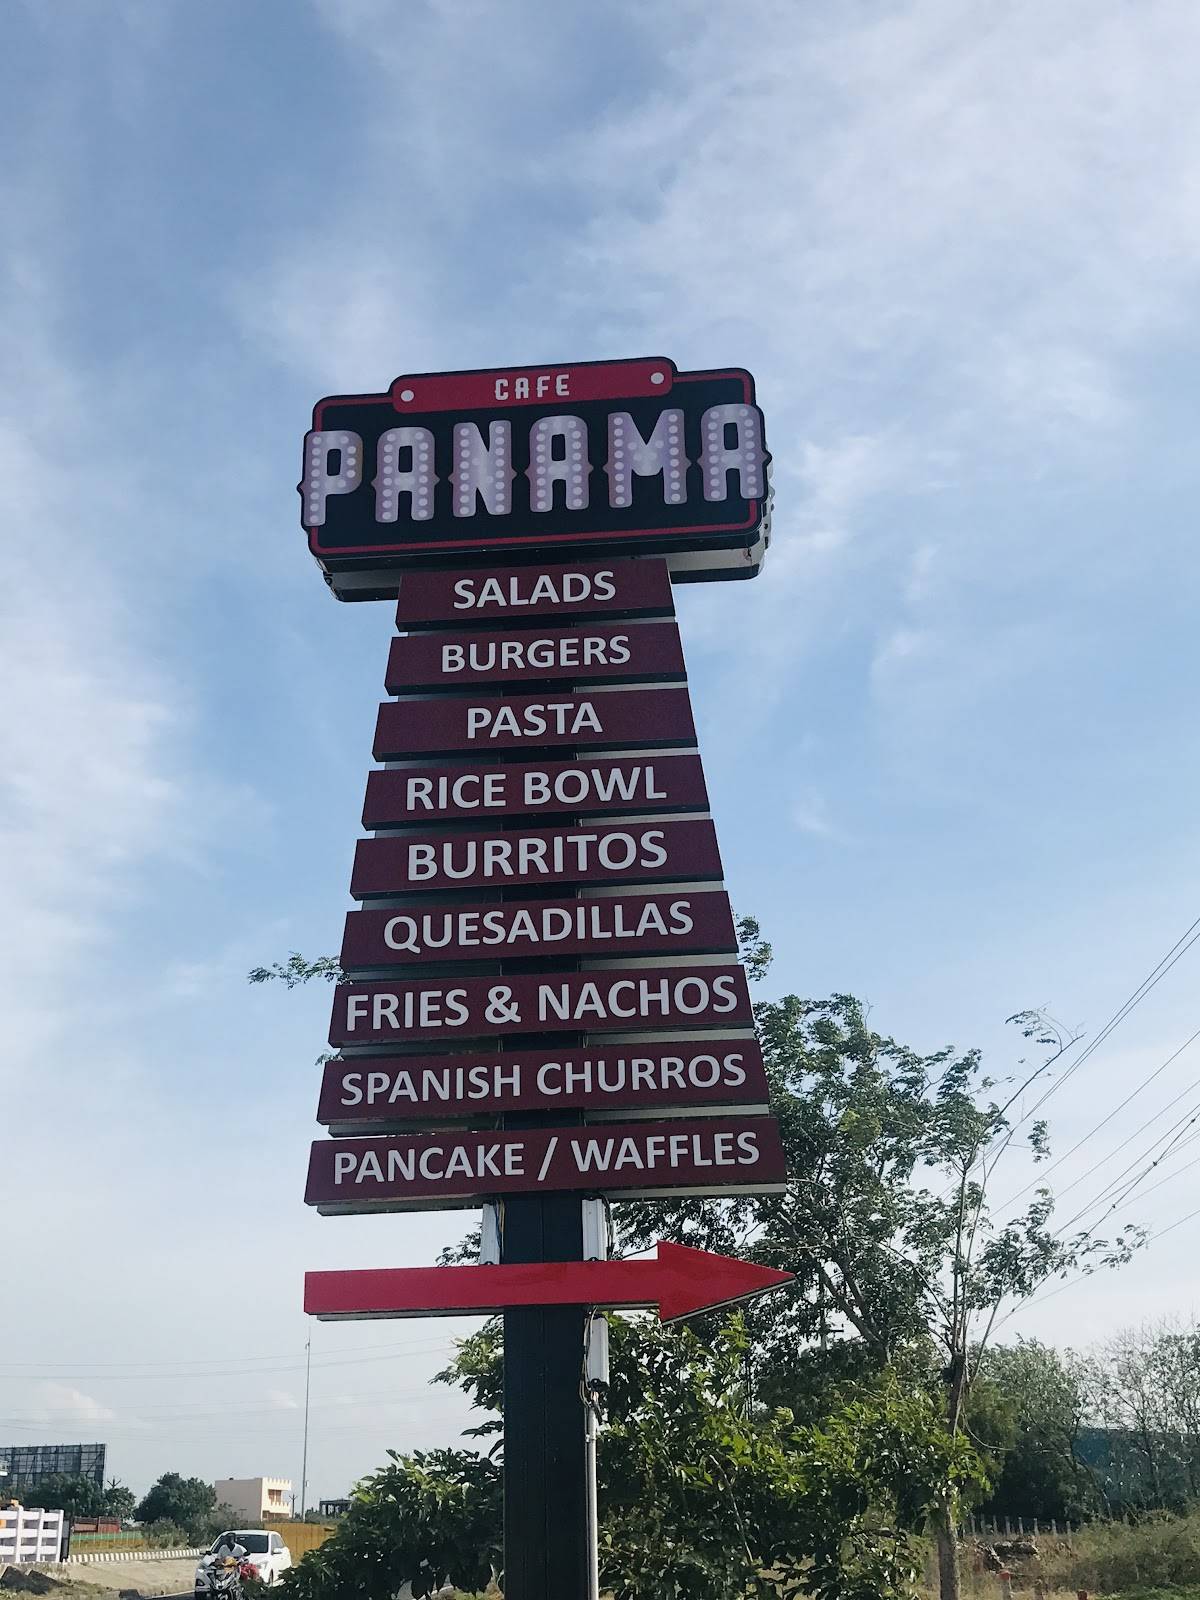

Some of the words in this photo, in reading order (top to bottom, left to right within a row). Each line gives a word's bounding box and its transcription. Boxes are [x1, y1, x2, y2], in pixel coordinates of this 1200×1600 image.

[495, 375, 569, 400] CAFE
[302, 403, 767, 527] PANAMA
[454, 571, 615, 608] SALADS
[443, 636, 630, 672] BURGERS
[468, 703, 602, 738] PASTA
[407, 774, 506, 810] RICE
[525, 767, 666, 804] BOWL
[409, 831, 667, 880] BURRITOS
[384, 901, 694, 954] QUESADILLAS
[347, 989, 469, 1031] FRIES
[485, 986, 521, 1023] &
[539, 976, 737, 1020] NACHOS
[341, 1065, 520, 1105] SPANISH
[537, 1054, 745, 1094] CHURROS
[335, 1144, 524, 1184] PANCAKE
[538, 1137, 558, 1180] /
[571, 1132, 759, 1171] WAFFLES
